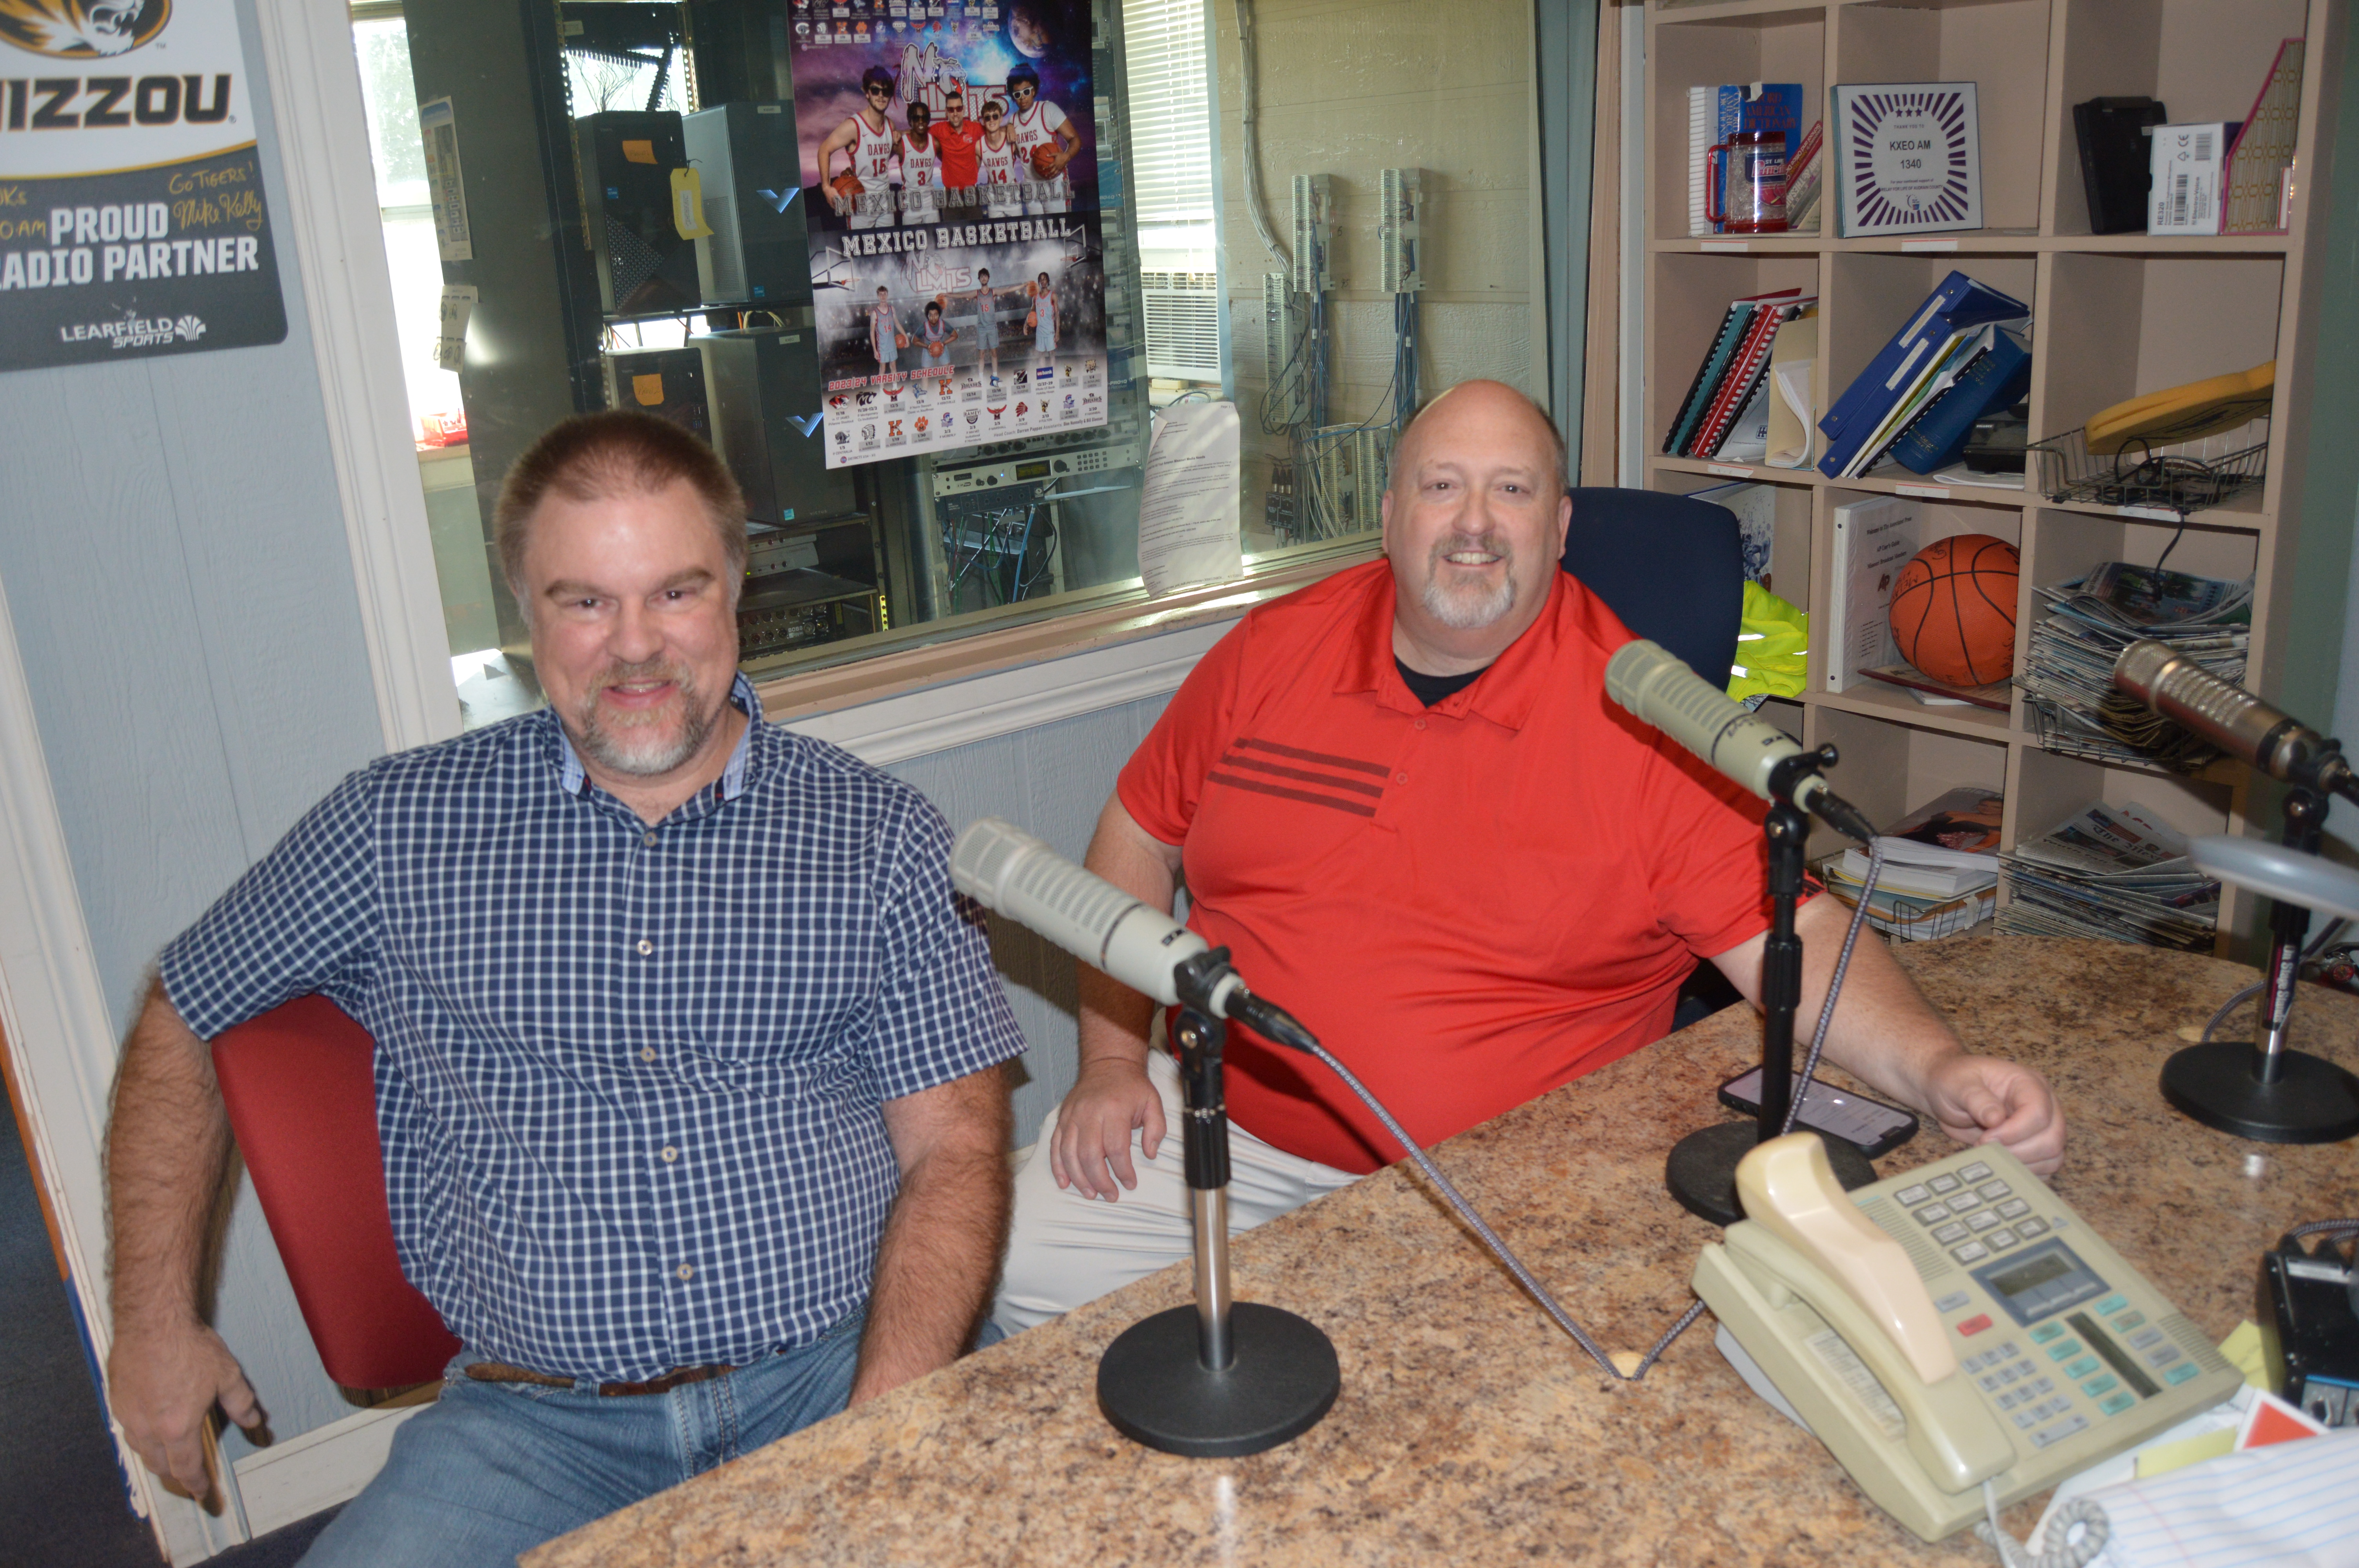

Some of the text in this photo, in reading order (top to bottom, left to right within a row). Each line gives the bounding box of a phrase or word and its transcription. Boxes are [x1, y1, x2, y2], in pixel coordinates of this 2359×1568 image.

[0, 74, 233, 131] IZZOU
[1745, 105, 1791, 116] AMERICAN
[1744, 118, 1797, 129] DICTIONARY
[1017, 130, 1038, 144] DAWGS
[868, 143, 890, 156] DAWGS
[1890, 140, 1931, 151] KXEO AM
[911, 158, 931, 168] DAWGS
[987, 156, 1008, 167] DAWGS
[1901, 159, 1921, 169] 1340
[918, 171, 925, 186] 3
[992, 169, 1007, 184] 14
[169, 173, 194, 195] Go
[834, 181, 1075, 216] MEXICO BASKETBALL
[173, 190, 264, 232] Mike Kelly
[51, 202, 169, 246] PROUD
[842, 218, 1070, 256] MEXICO BASKETBALL
[0, 236, 259, 291] ADIO PARTNER
[1040, 309, 1045, 318] 3
[61, 318, 174, 343] LEARFIELD
[884, 324, 892, 333] 14
[113, 332, 174, 349] SPORTS
[871, 371, 907, 385] VARSITY
[911, 365, 955, 379] SCHEDULE
[961, 381, 982, 390] PIRATES
[1083, 396, 1102, 404] PIRATES
